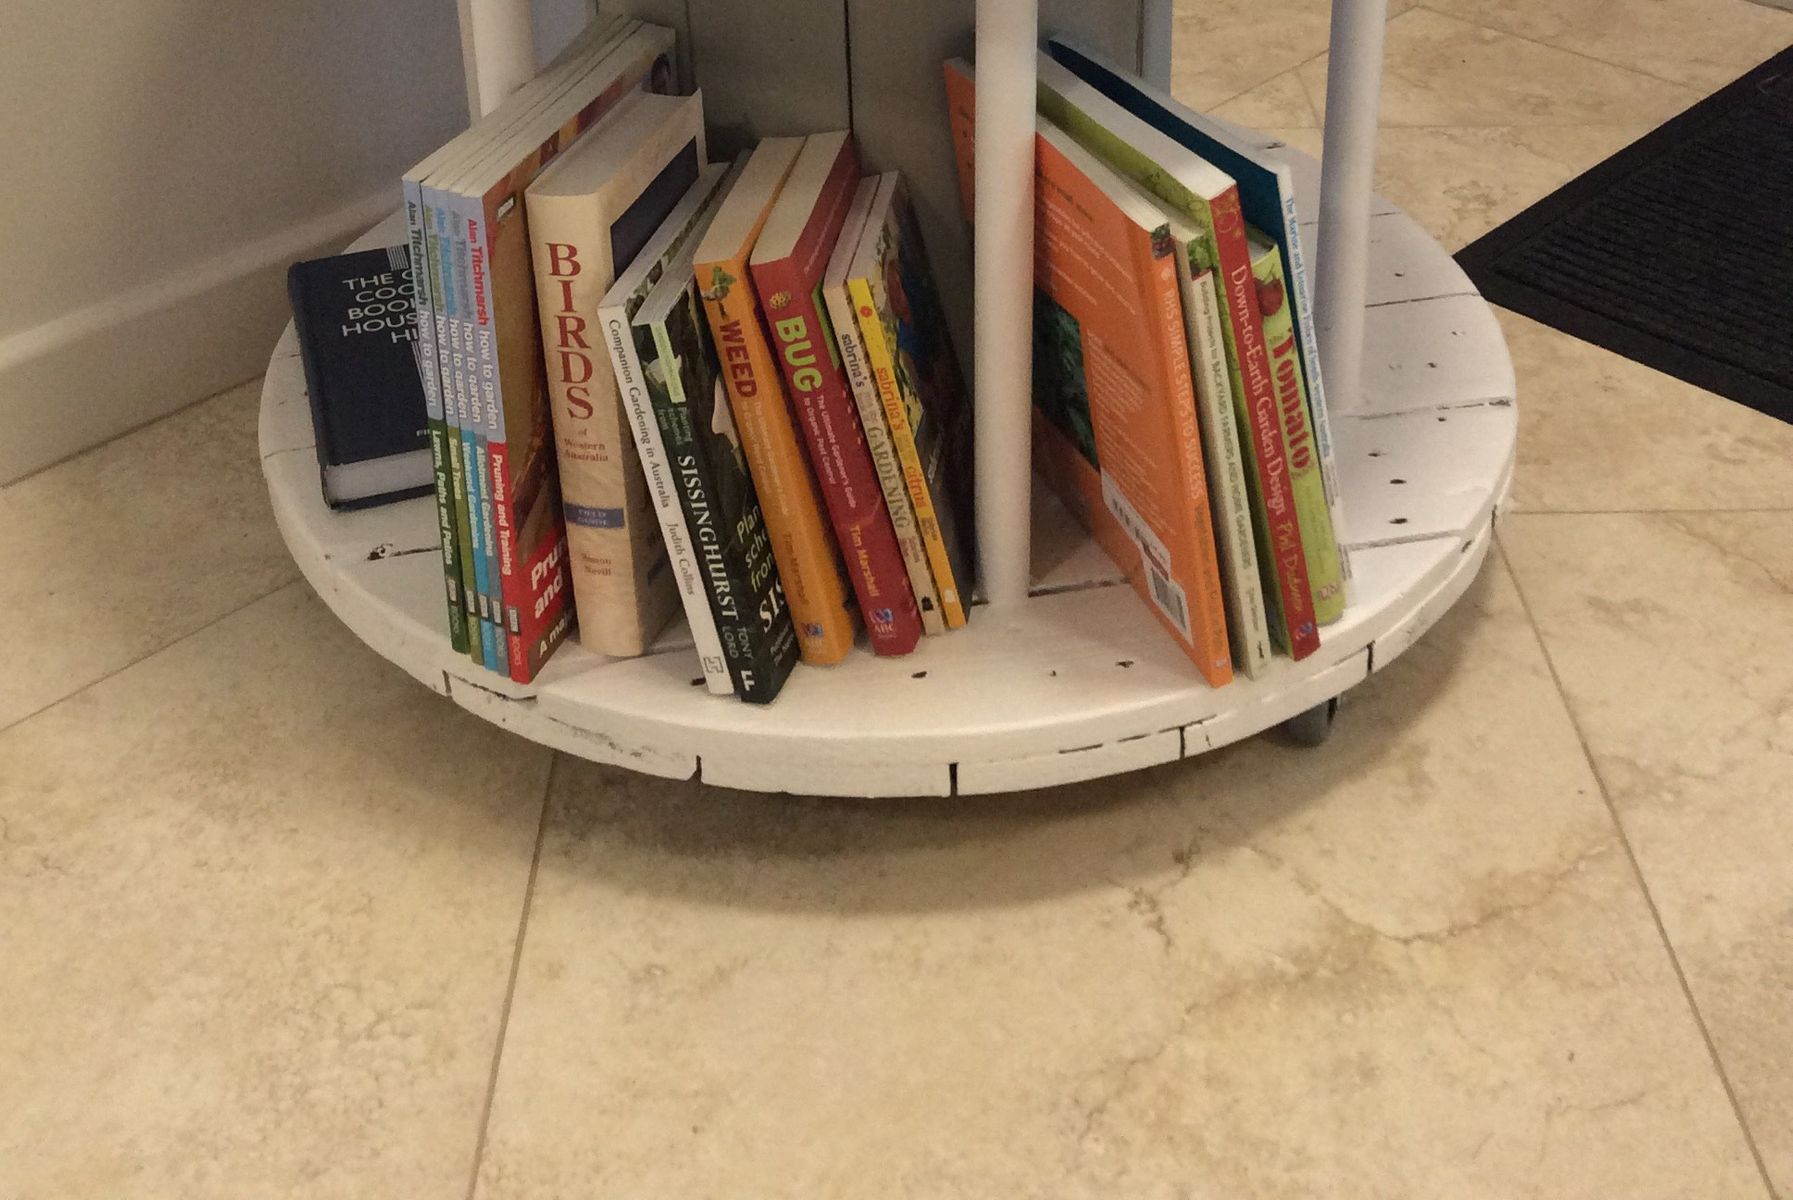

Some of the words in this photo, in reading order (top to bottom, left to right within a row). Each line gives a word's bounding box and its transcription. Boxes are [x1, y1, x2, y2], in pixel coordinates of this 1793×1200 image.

[408, 201, 416, 226] Alan
[1286, 197, 1294, 214] The
[468, 218, 477, 243] Alan
[342, 272, 394, 291] THE
[411, 228, 428, 306] Titchmarsh
[355, 283, 416, 303] COO
[471, 246, 490, 326] Titchmarsh
[1164, 288, 1178, 320] RHS
[341, 313, 419, 336] HOUS
[348, 298, 417, 320] BOO
[419, 310, 430, 340] how
[436, 315, 447, 346] how
[449, 318, 460, 349] how
[463, 322, 474, 353] how
[479, 330, 490, 361] how
[545, 242, 594, 420] BIRDS
[1168, 319, 1186, 371] SIMPLE
[1231, 264, 1267, 396] Down-to-Earth
[423, 343, 433, 357] to
[440, 349, 450, 364] to
[453, 353, 463, 367] to
[467, 356, 478, 371] to
[719, 319, 758, 399] WEED
[775, 315, 823, 393] BUG
[841, 333, 865, 388] sabrina's
[423, 360, 438, 407] garden
[482, 364, 494, 378] to
[1211, 359, 1229, 417] BACKYARD
[441, 367, 455, 415] garden
[455, 370, 468, 418] garden
[468, 374, 481, 423] garden
[482, 381, 498, 430] garden
[876, 367, 905, 431] sabrina's
[1175, 372, 1192, 419] STEPS
[1272, 327, 1311, 470] Tomato
[609, 319, 633, 384] Companion
[629, 387, 651, 445] Gardening
[645, 447, 654, 458] in
[650, 461, 671, 508] Australia
[1182, 419, 1194, 437] TO
[1256, 395, 1279, 456] Garden
[449, 438, 460, 470] Small
[563, 449, 609, 462] Australia
[564, 438, 605, 451] Western
[452, 470, 462, 500] Trees
[492, 454, 505, 502] Pruning
[867, 426, 910, 529] GARDENING
[905, 465, 926, 508] citrus
[1184, 437, 1201, 499] SUCCESS
[1266, 455, 1287, 516] Design
[436, 472, 447, 504] Paths
[439, 507, 450, 532] and
[497, 503, 509, 527] and
[736, 504, 760, 544] Plan
[442, 530, 452, 565] Patios
[500, 528, 512, 576] Training
[678, 455, 740, 621] SISSINGHURST
[665, 522, 684, 556] Judith
[678, 558, 695, 596] Collins
[851, 524, 862, 547] Tim
[857, 549, 880, 597] Marshall
[722, 626, 740, 659] LORD
[737, 626, 754, 659] TONY
